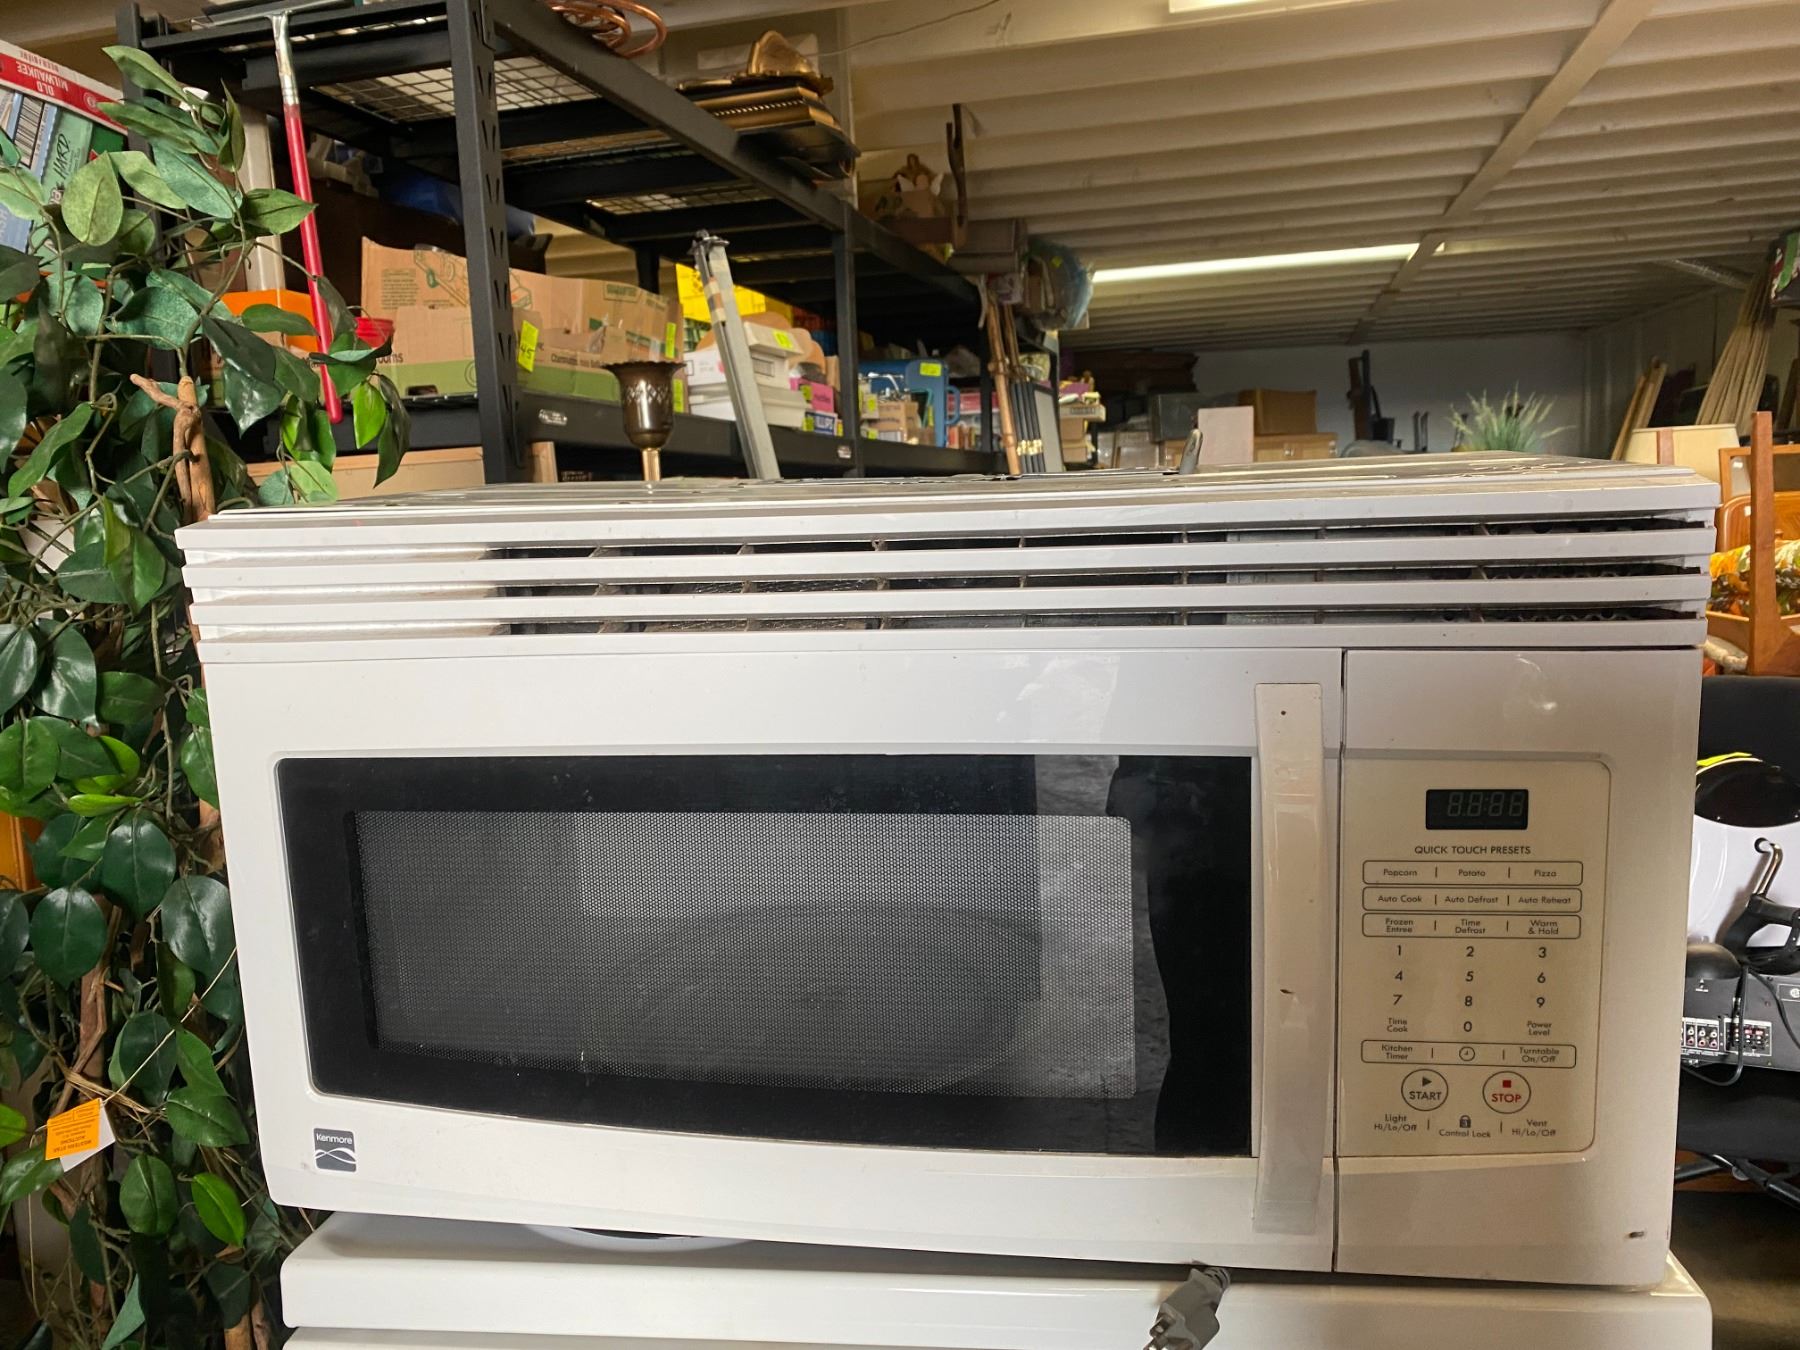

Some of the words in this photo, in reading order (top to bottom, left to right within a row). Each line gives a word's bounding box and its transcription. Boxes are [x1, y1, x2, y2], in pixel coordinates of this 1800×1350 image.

[16, 61, 68, 91] MILWAUKEE
[37, 82, 55, 96] OLD
[53, 133, 70, 180] HARD
[1414, 845, 1448, 855] QUICK
[1452, 845, 1487, 855] TOUCH
[1490, 845, 1531, 855] PRESETS
[1383, 868, 1417, 876] Popcorn
[1458, 869, 1486, 877] Potato
[1468, 895, 1498, 904] Defrost
[1541, 896, 1571, 904] Reheat
[1461, 919, 1480, 927] Time
[1455, 926, 1485, 934] Defrost
[1397, 945, 1401, 956] 1
[1466, 946, 1474, 957] 2
[1538, 947, 1546, 958] 3
[1395, 970, 1403, 981] 4
[1466, 971, 1474, 982] 5
[1537, 972, 1546, 983] 6
[1393, 994, 1403, 1006] 7
[1465, 996, 1473, 1007] 8
[1537, 997, 1545, 1008] 9
[1388, 1017, 1408, 1025] Time
[1464, 1021, 1472, 1032] 0
[1529, 1028, 1550, 1036] Level
[1382, 1044, 1413, 1052] Kitchen
[1520, 1047, 1559, 1055] Turntable
[1409, 1091, 1442, 1100] START
[1492, 1094, 1522, 1103] STOP
[1385, 1114, 1407, 1123] Light
[1439, 1129, 1469, 1137] Control
[315, 1132, 353, 1145] Kenmore
